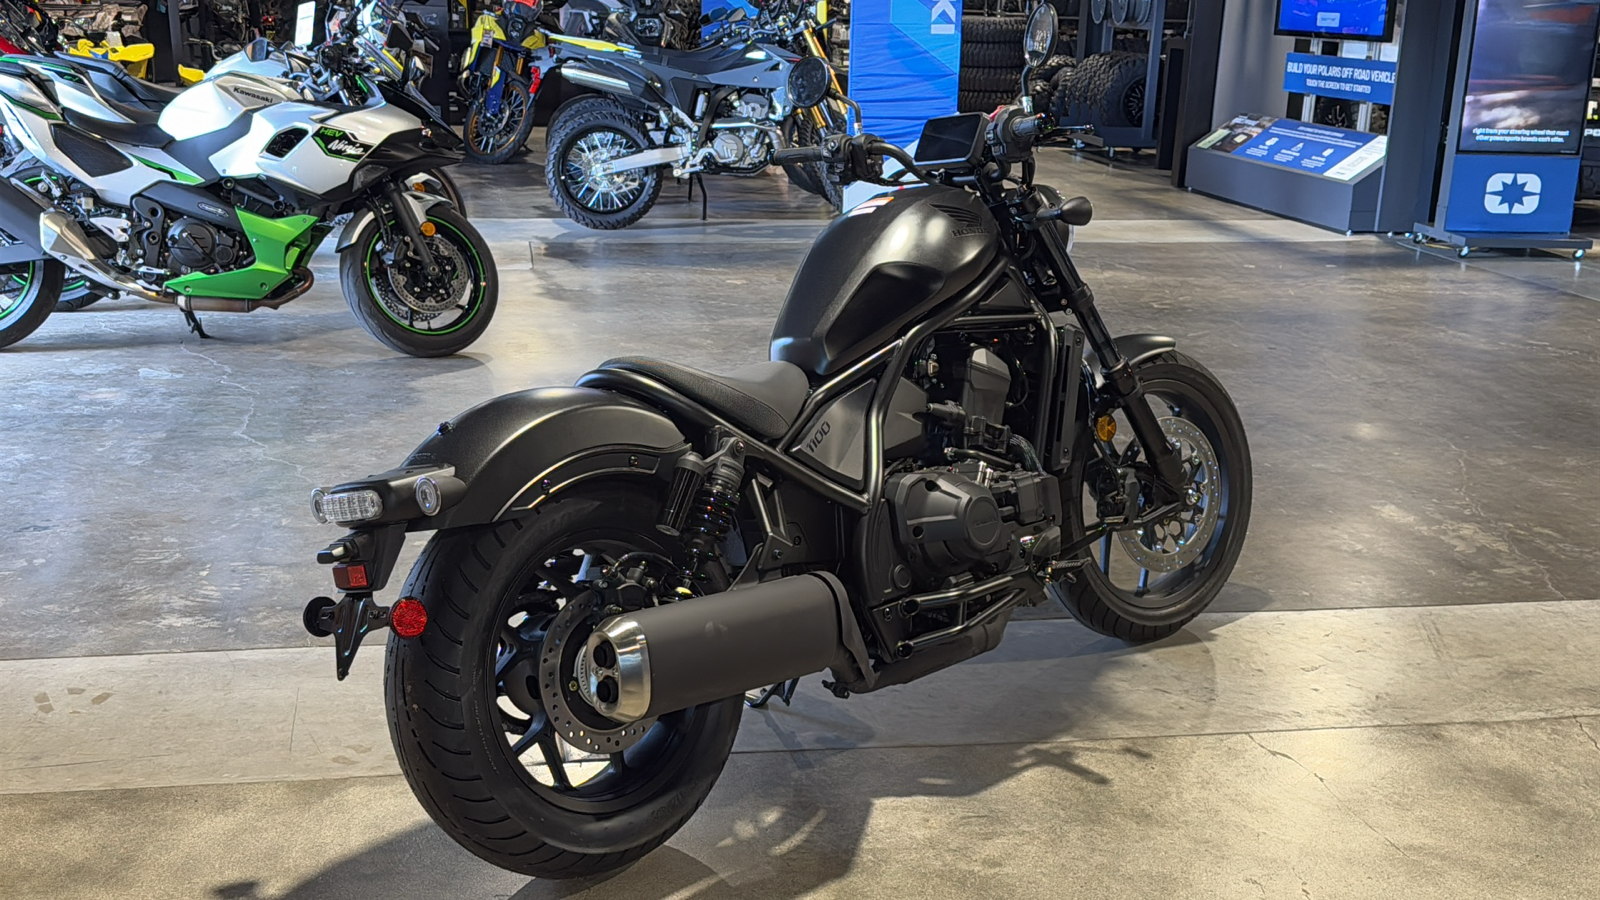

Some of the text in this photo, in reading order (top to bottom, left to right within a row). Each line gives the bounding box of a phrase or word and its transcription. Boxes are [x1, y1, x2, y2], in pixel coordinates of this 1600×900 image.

[1287, 62, 1303, 74] BUILD
[1304, 64, 1318, 76] YOUR
[1318, 65, 1341, 78] POLARIS
[1342, 67, 1354, 79] OFF
[1354, 69, 1370, 82] ROAD
[233, 86, 274, 104] Kawasaki
[1325, 81, 1339, 90] SCREEN
[1353, 85, 1371, 94] STARTED
[320, 127, 344, 138] HEV
[327, 139, 366, 156] Ninja
[952, 227, 990, 238] HONDA
[806, 421, 831, 453] 1100
